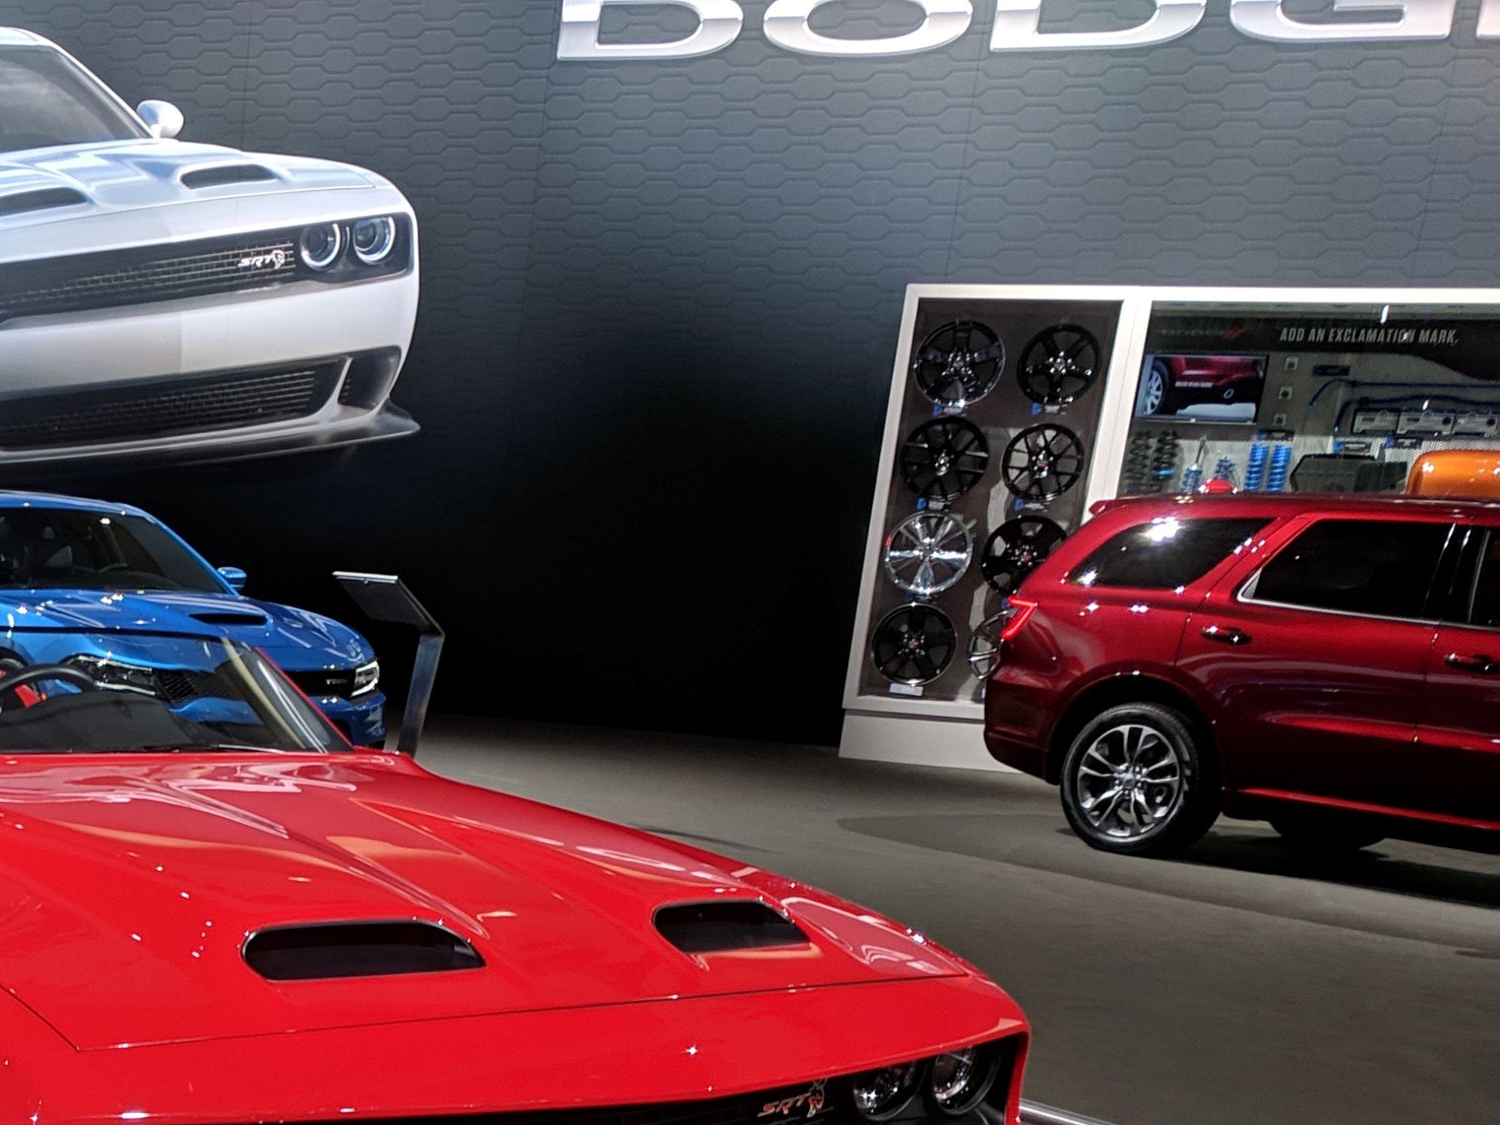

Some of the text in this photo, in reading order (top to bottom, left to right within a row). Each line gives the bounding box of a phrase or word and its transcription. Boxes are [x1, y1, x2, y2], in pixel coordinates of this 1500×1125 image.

[557, 0, 1500, 60] DODG
[237, 254, 274, 268] SRT
[1279, 327, 1305, 342] ADD
[1308, 328, 1326, 342] AN
[1328, 328, 1416, 344] EXCLAMATION
[757, 1092, 812, 1117] SRT
